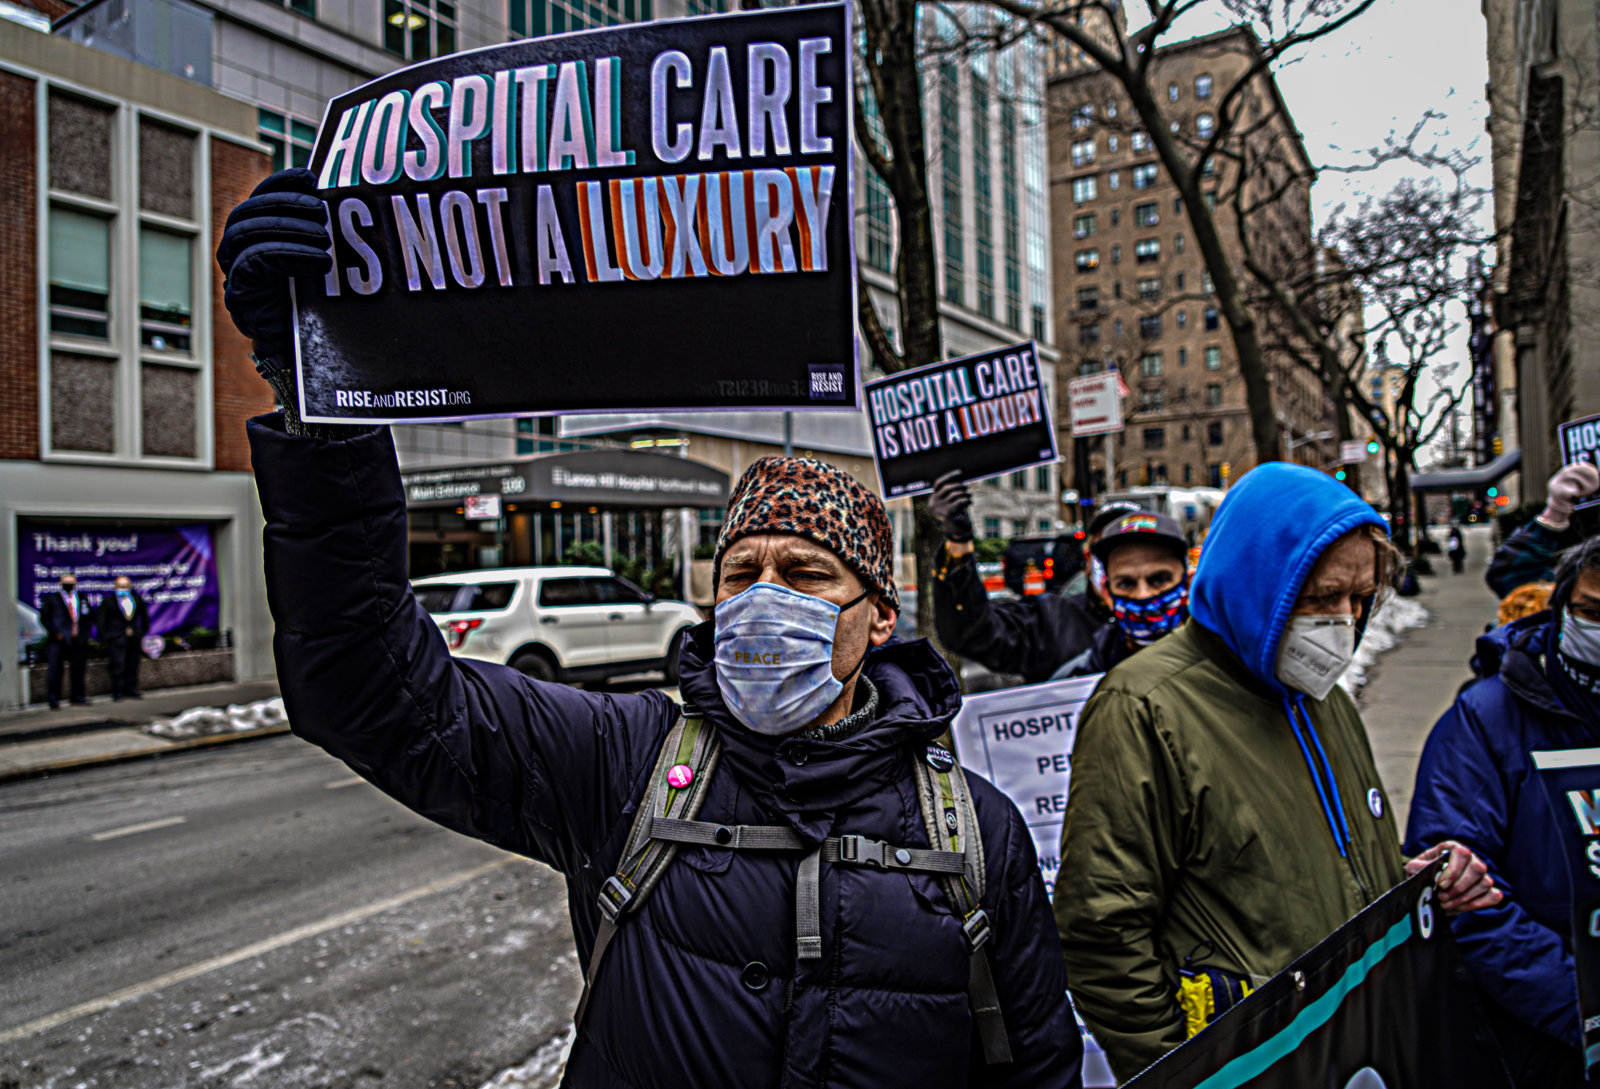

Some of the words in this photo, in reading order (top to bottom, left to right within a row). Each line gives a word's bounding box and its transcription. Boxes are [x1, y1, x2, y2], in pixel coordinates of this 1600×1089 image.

[317, 56, 636, 190] HOSPITAL
[650, 37, 834, 163] CARE
[391, 187, 513, 292] NOT
[536, 184, 576, 285] A
[576, 165, 836, 283] LUXURY
[870, 367, 977, 426] HOSPITAL
[975, 351, 1038, 399] CARE
[876, 425, 900, 460] IS
[899, 411, 941, 454] NOT
[944, 409, 962, 445] A
[959, 388, 1043, 440] LUXURY
[33, 532, 93, 552] Thank
[95, 533, 138, 557] you!
[735, 651, 781, 666] PEACE
[993, 711, 1082, 741] HOSPIT
